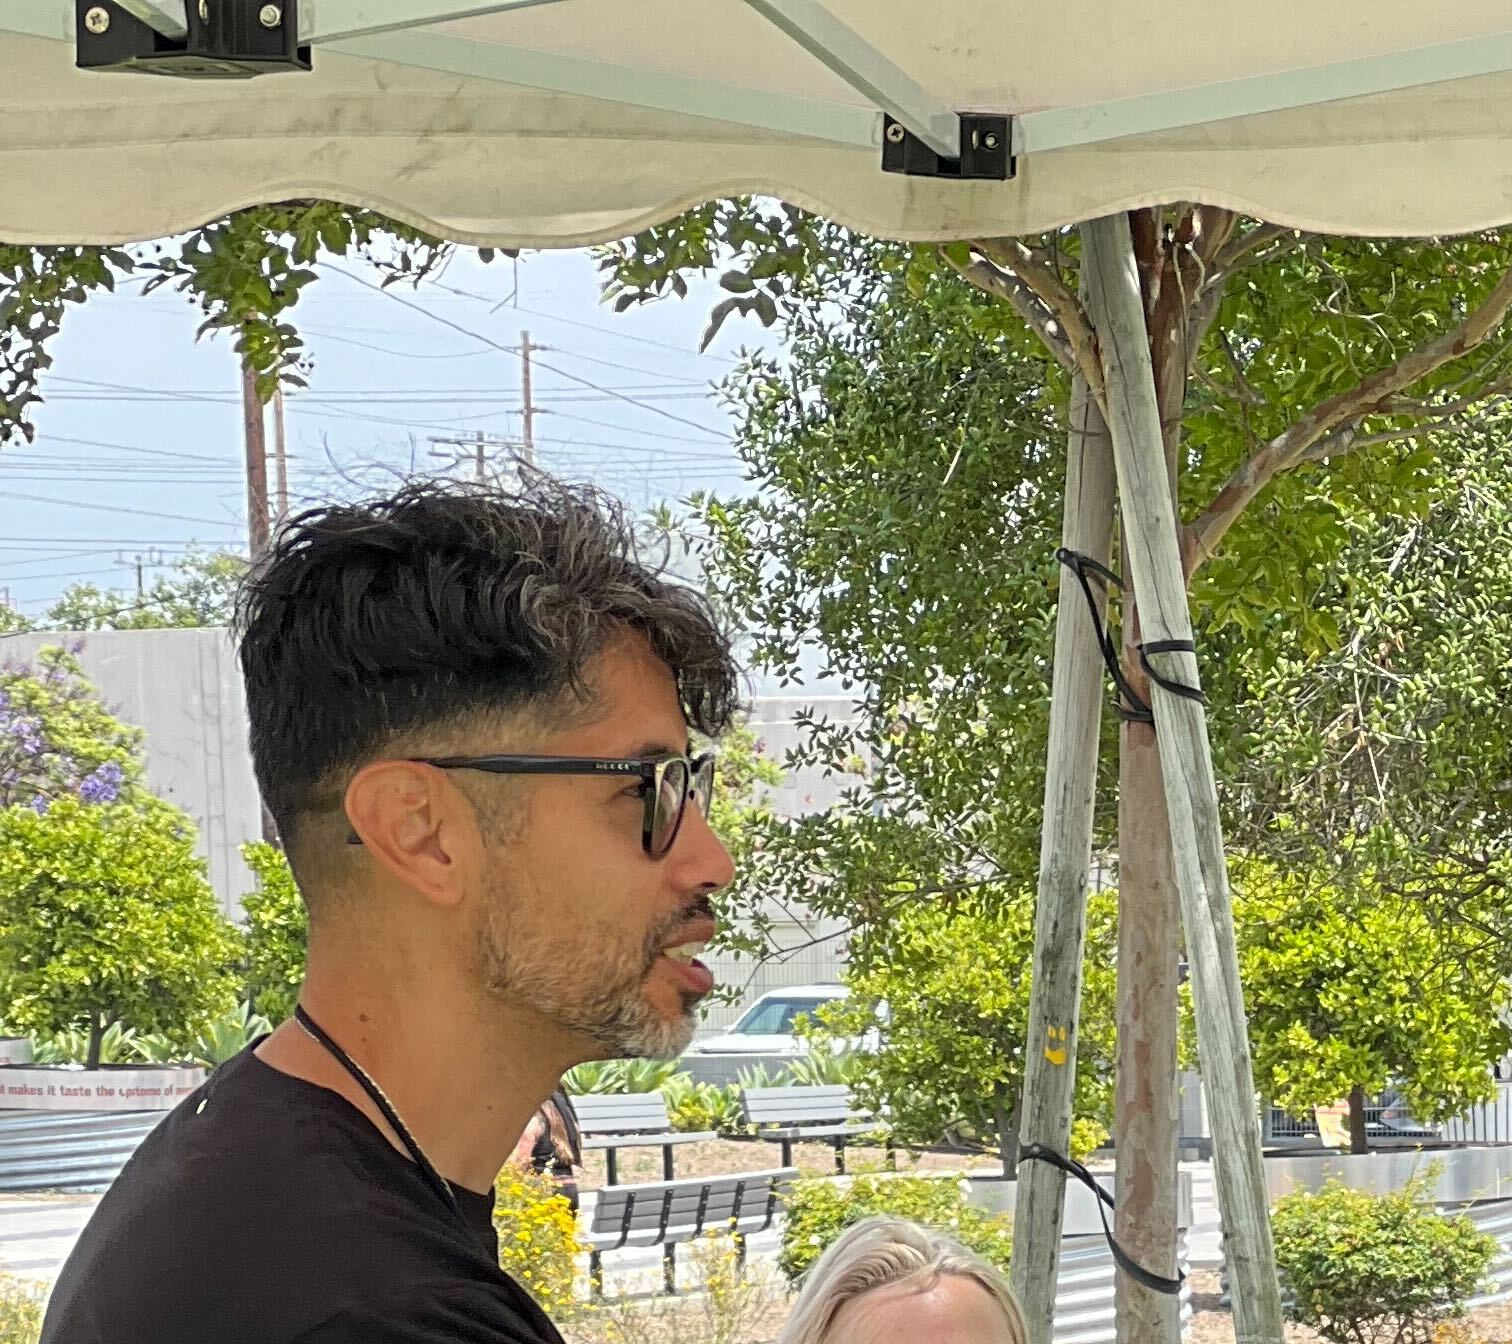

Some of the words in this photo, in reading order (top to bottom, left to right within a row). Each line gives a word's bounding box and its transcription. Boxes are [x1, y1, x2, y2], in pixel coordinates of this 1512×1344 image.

[8, 1085, 43, 1096] makes
[47, 1085, 56, 1096] it
[60, 1085, 91, 1097] taste
